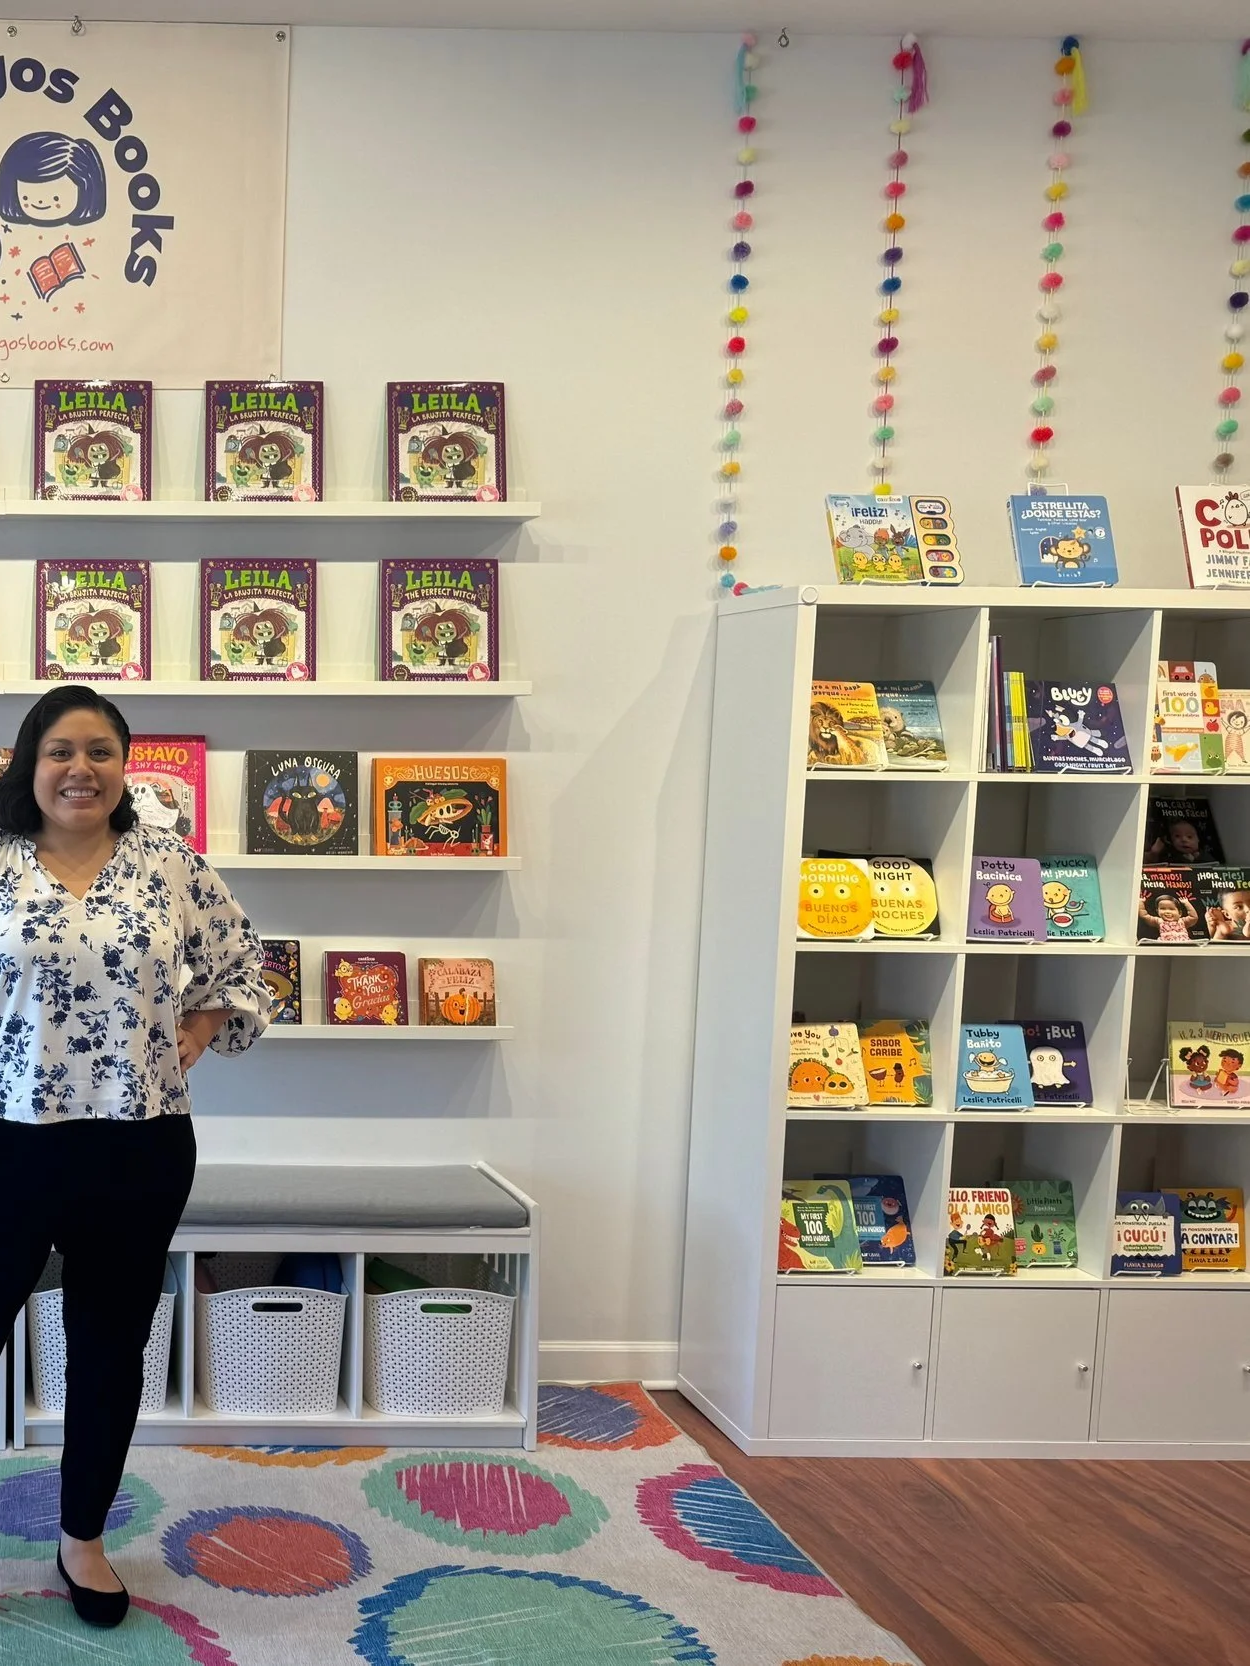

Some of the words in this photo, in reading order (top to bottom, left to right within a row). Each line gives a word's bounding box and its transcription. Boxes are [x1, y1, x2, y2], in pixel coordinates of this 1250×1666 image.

[83, 87, 174, 287] Books
[59, 391, 127, 412] LEILA
[230, 392, 299, 413] LEILA
[411, 393, 481, 413] LEILA
[68, 409, 98, 420] BRUJITA
[99, 410, 130, 422] PERFECTA
[240, 410, 269, 420] BRUJITA
[270, 410, 301, 423] PERFECTA
[411, 415, 420, 423] LA
[422, 411, 450, 420] BRUJITA
[452, 411, 483, 423] PERFECTA
[1030, 501, 1089, 510] ESTRELLITA
[851, 506, 889, 518] ¡Feliz!
[1020, 508, 1064, 520] ¿DÓNDE
[1065, 508, 1101, 519] ESTÁS?
[1206, 554, 1240, 566] JIMMY
[60, 571, 128, 592] LEILA
[224, 570, 293, 591] LEILA
[405, 570, 475, 591] LEILA
[232, 588, 263, 599] BRUJITA
[264, 588, 295, 600] PERFECTA
[405, 590, 419, 600] THE
[420, 587, 452, 598] PERFECT
[453, 588, 477, 600] WITCH
[1050, 686, 1092, 706] BLUEY
[1162, 689, 1176, 697] first
[1161, 696, 1199, 713] 100
[134, 761, 151, 771] SHY
[153, 762, 182, 773] GHOST
[271, 757, 299, 777] LUNA
[304, 756, 341, 779] OSCURA
[413, 764, 470, 780] HUESOS
[808, 862, 847, 872] GOOD
[872, 860, 911, 870] GOOD
[981, 860, 1015, 872] Potty
[1054, 859, 1089, 868] YUCKY
[873, 871, 912, 881] NIGHT
[976, 870, 1023, 882] Bacinica
[1054, 869, 1089, 880] ¡PUAJ!
[805, 903, 859, 913] BUENOS
[871, 898, 923, 908] BUENAS
[817, 912, 848, 924] DÍAS
[871, 910, 925, 920] NOCHES
[973, 928, 995, 936] Leslie
[997, 929, 1035, 937] Patricelli
[1059, 929, 1093, 937] Patricelli
[436, 967, 482, 978] CALABAZA
[347, 973, 388, 989] THANK
[443, 976, 475, 985] FELIZ
[352, 993, 390, 1010] Gracias
[804, 1029, 821, 1039] You
[965, 1028, 1000, 1039] Tubby
[1045, 1025, 1077, 1041] ¡Bu!
[870, 1038, 901, 1047] SABOR
[966, 1038, 1002, 1048] Bañito
[869, 1048, 903, 1057] CARIBE
[962, 1096, 985, 1104] Leslie
[986, 1096, 1022, 1104] Patricelli
[971, 1190, 1009, 1203] FRIEND
[1026, 1197, 1043, 1206] Little
[1044, 1197, 1063, 1205] Plants
[974, 1203, 1010, 1215] AMIGO
[800, 1212, 809, 1220] MY
[857, 1211, 876, 1225] 100
[804, 1220, 824, 1234] 100
[1191, 1232, 1238, 1245] CONTAR!
